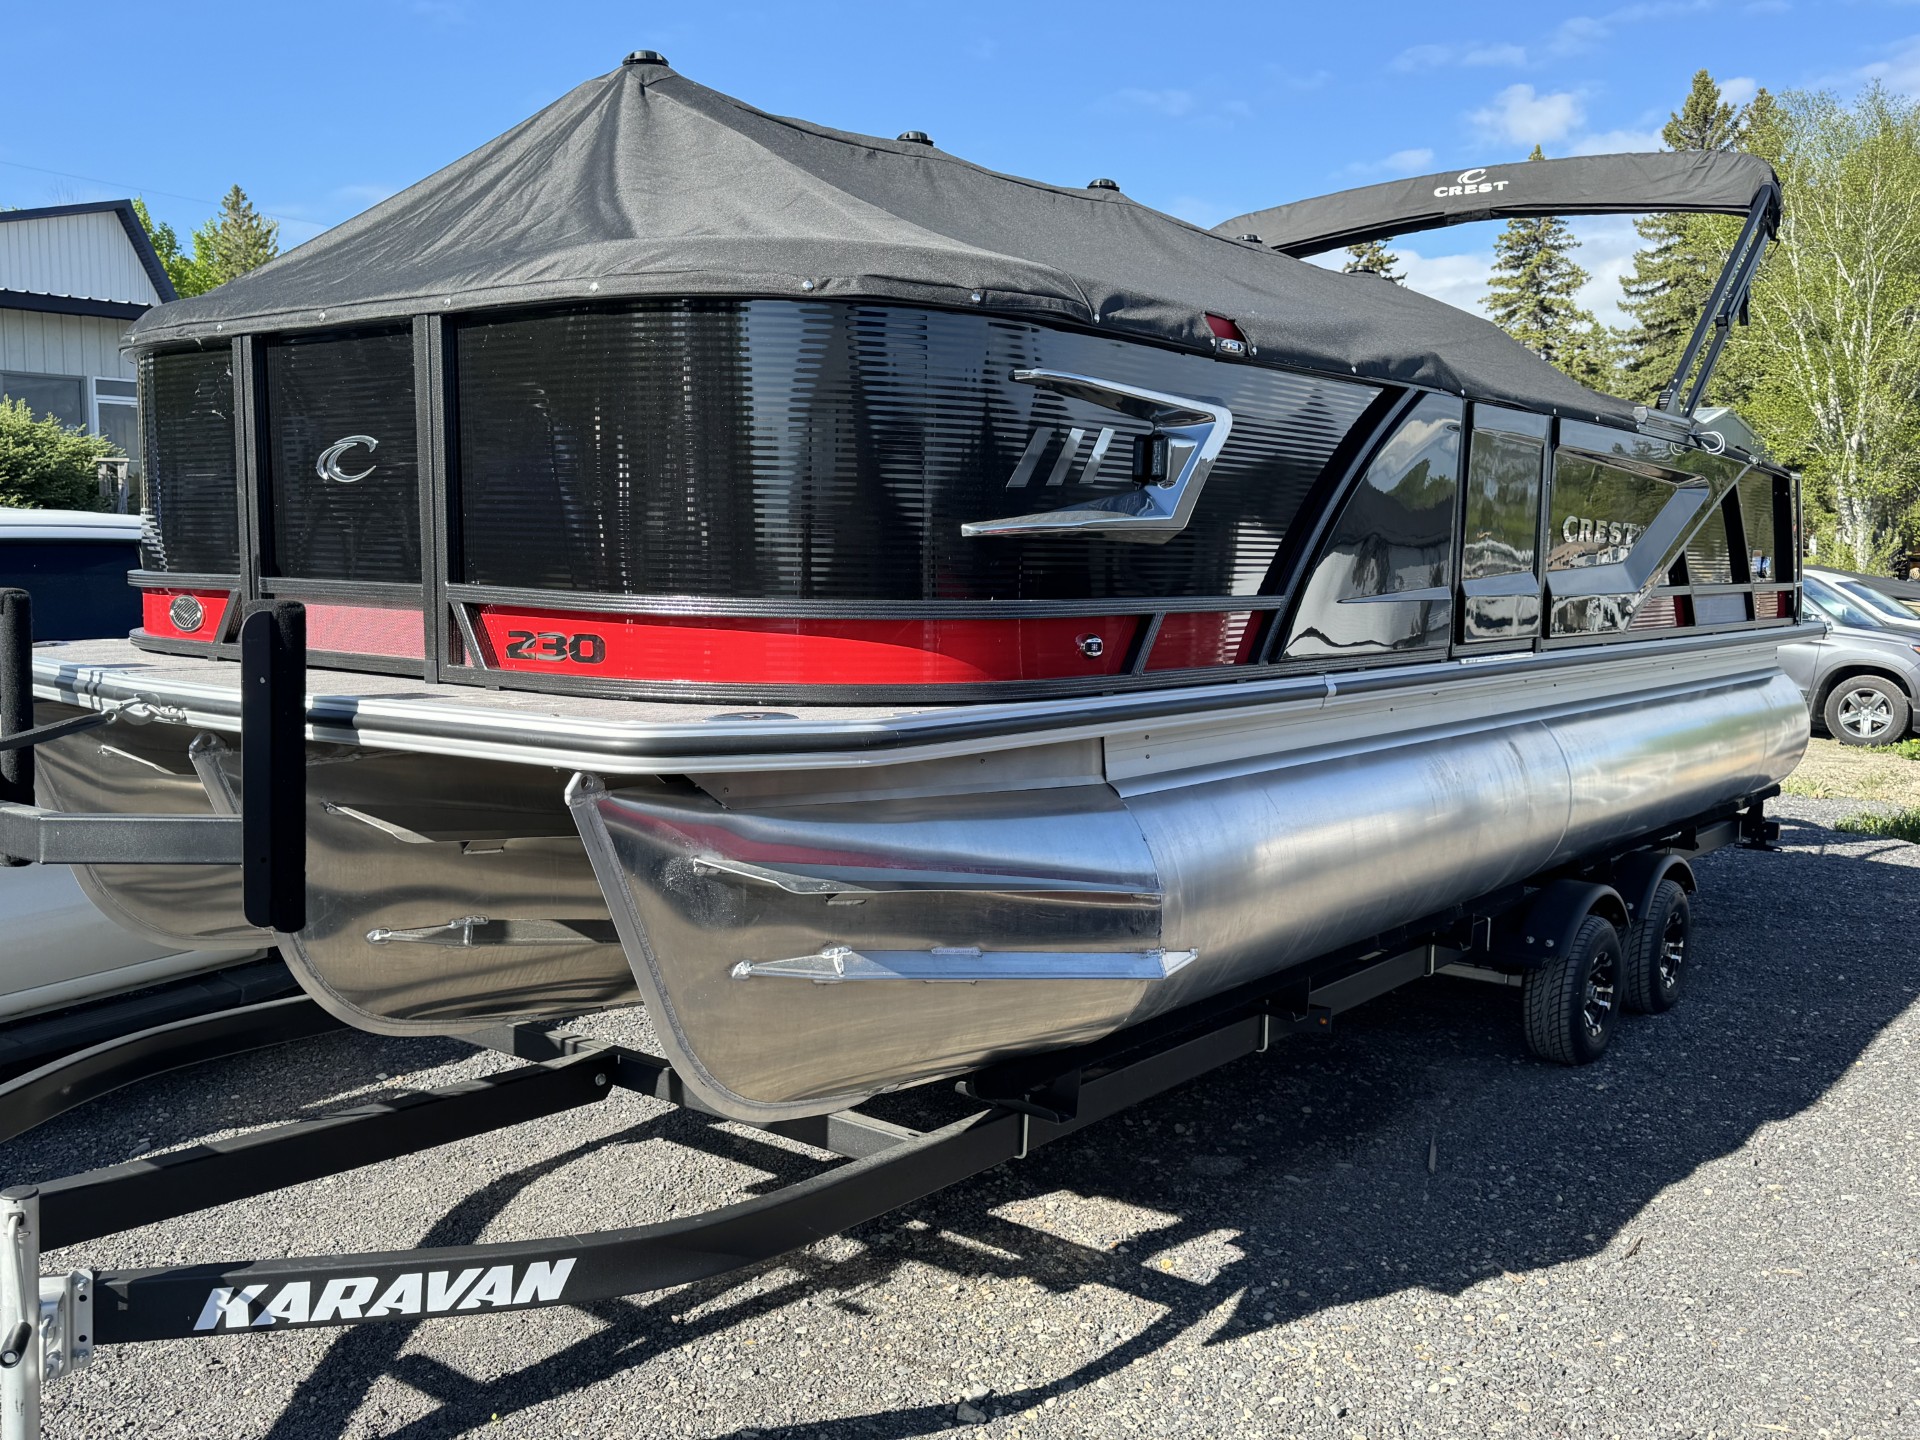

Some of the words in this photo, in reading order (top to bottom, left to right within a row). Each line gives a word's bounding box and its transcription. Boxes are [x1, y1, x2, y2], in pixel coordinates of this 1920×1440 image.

[1433, 181, 1509, 198] CREST
[1562, 515, 1640, 545] CREST
[506, 630, 606, 663] 230
[193, 1257, 577, 1331] KARAVAN
